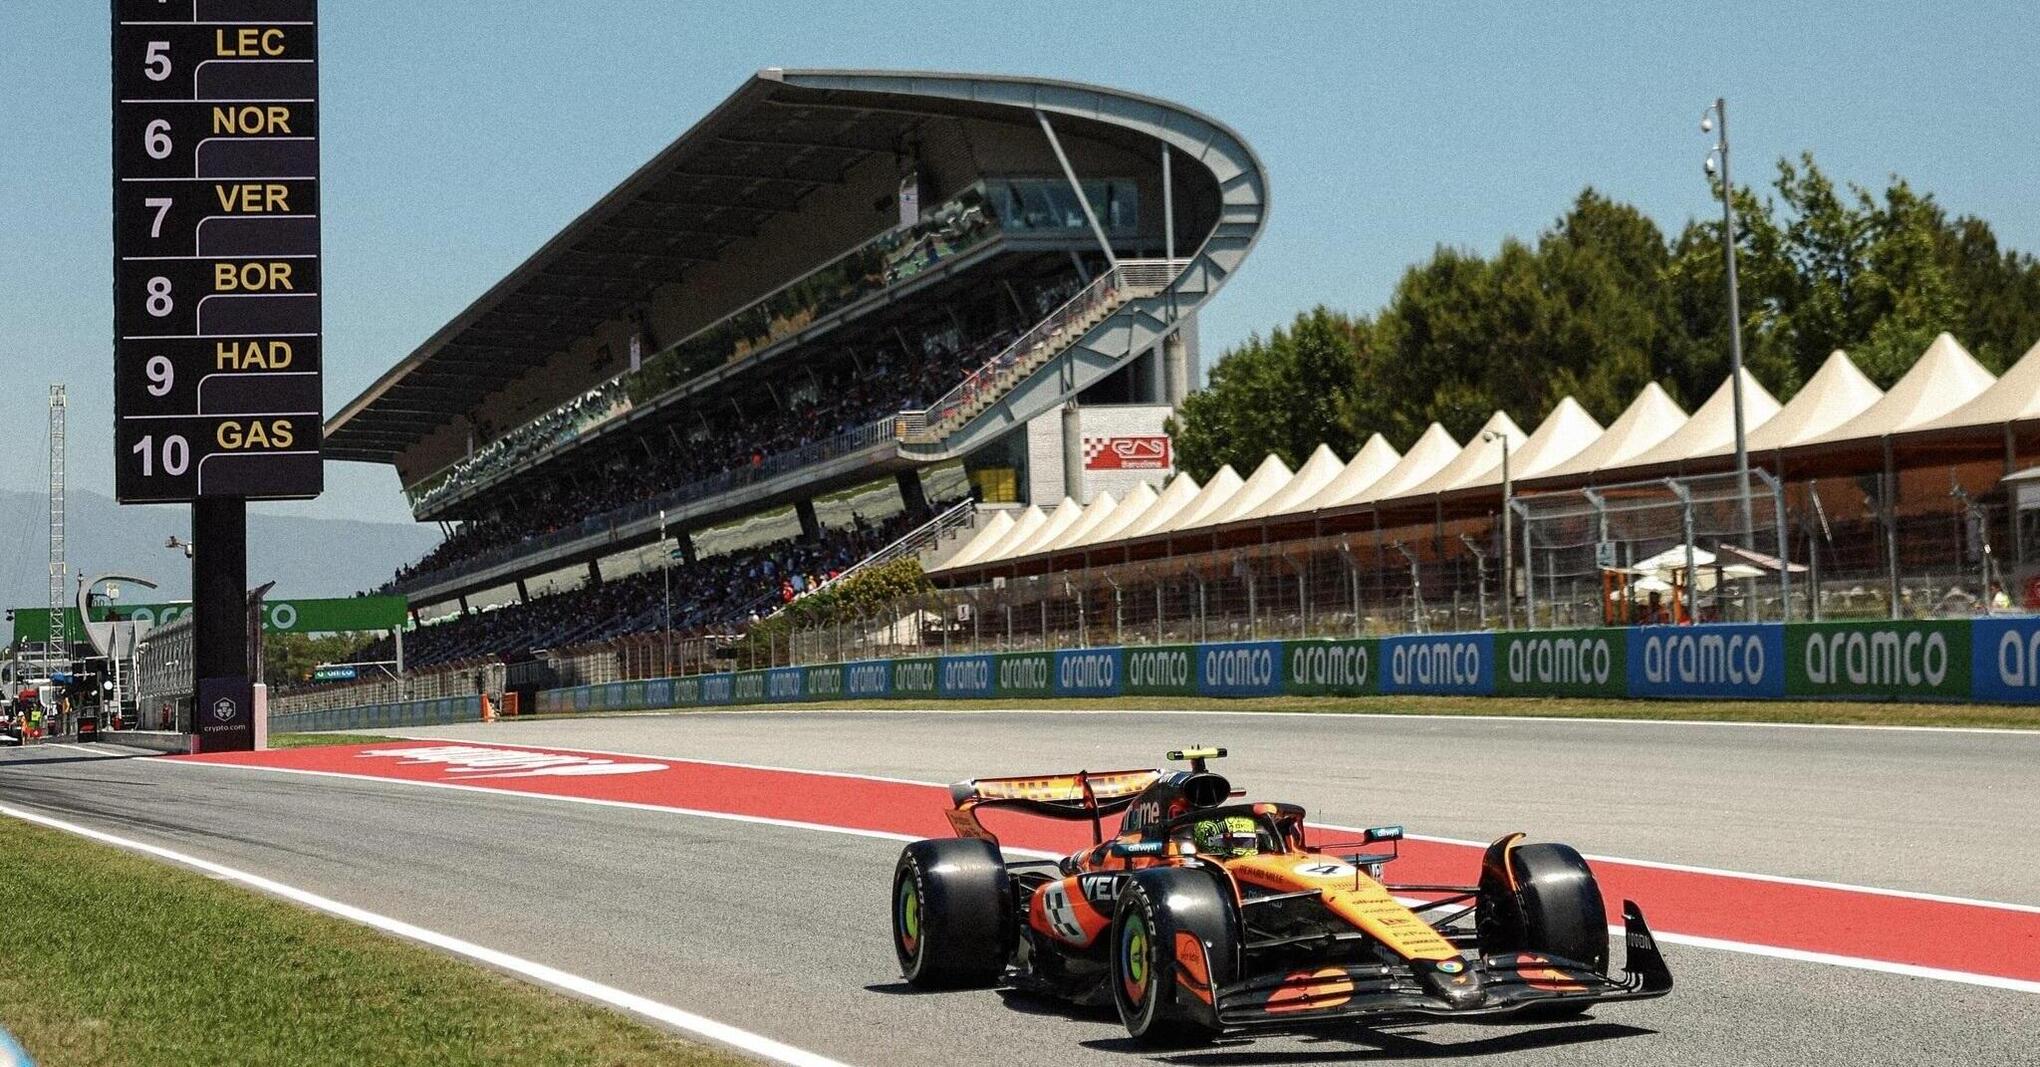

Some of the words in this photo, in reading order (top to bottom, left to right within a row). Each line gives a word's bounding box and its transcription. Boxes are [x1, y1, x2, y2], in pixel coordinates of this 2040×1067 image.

[144, 41, 172, 81] 5
[216, 29, 285, 56] LEC
[144, 119, 173, 159] 6
[213, 107, 291, 134] NOR
[145, 198, 173, 238] 7
[216, 185, 290, 212] VER
[146, 276, 173, 317] 8
[215, 263, 293, 290] BOR
[146, 356, 174, 397] 9
[216, 341, 292, 369] HAD
[133, 435, 190, 476] 10
[217, 420, 293, 449] GAS
[895, 663, 934, 690] aramco
[945, 660, 988, 689] aramco
[1001, 657, 1047, 689] aramco
[1061, 655, 1114, 688] aramco
[1130, 651, 1188, 686] aramco
[1206, 648, 1272, 687] aramco
[1292, 646, 1368, 686] aramco
[1392, 642, 1479, 685] aramco
[1508, 638, 1610, 685] aramco
[1644, 634, 1765, 685] aramco
[1806, 630, 1948, 687] aramco
[809, 668, 840, 694] aramco
[850, 665, 886, 692] aramco
[204, 724, 246, 732] crypto.com
[1128, 843, 1157, 853] allwyn
[1306, 865, 1341, 875] 4
